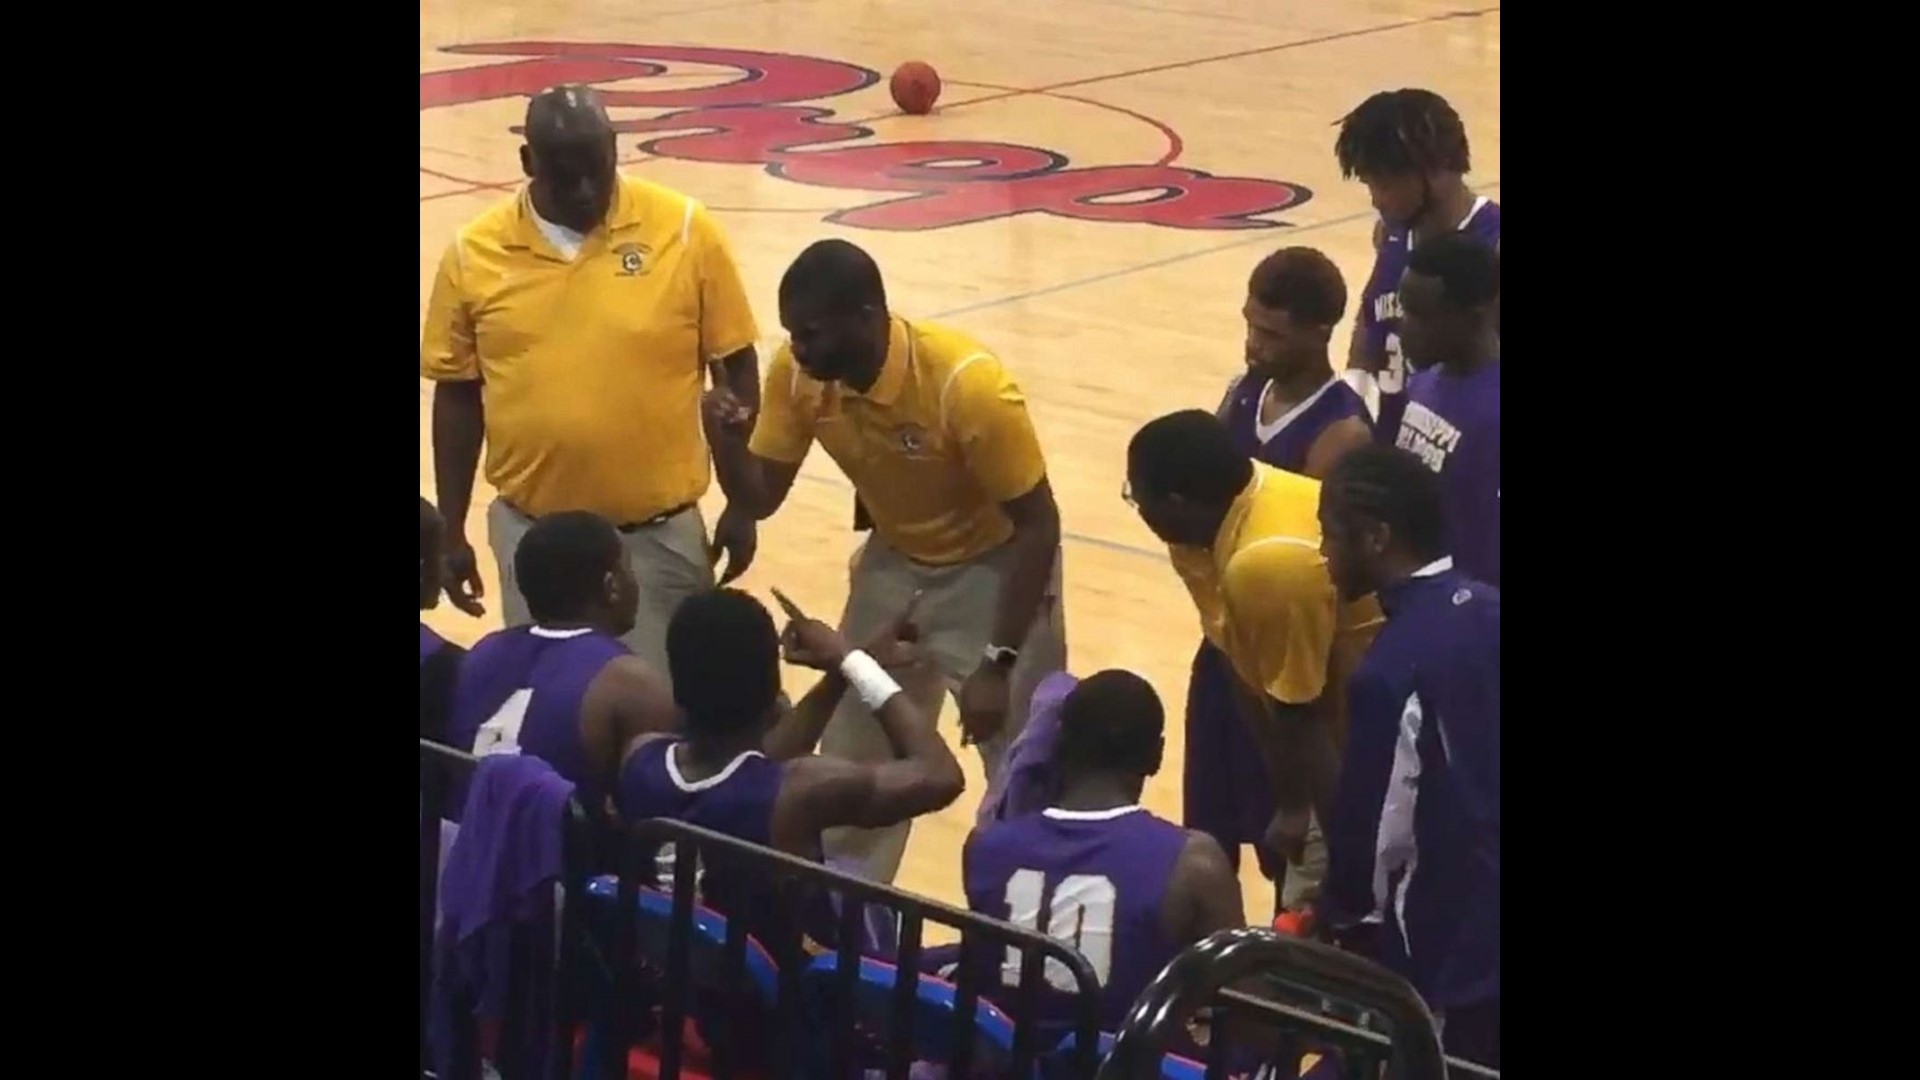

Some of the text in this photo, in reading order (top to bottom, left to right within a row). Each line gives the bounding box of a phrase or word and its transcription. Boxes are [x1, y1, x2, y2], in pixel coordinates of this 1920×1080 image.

[420, 42, 1313, 230] Prep
[472, 687, 534, 757] 4
[1001, 867, 1116, 994] 10
